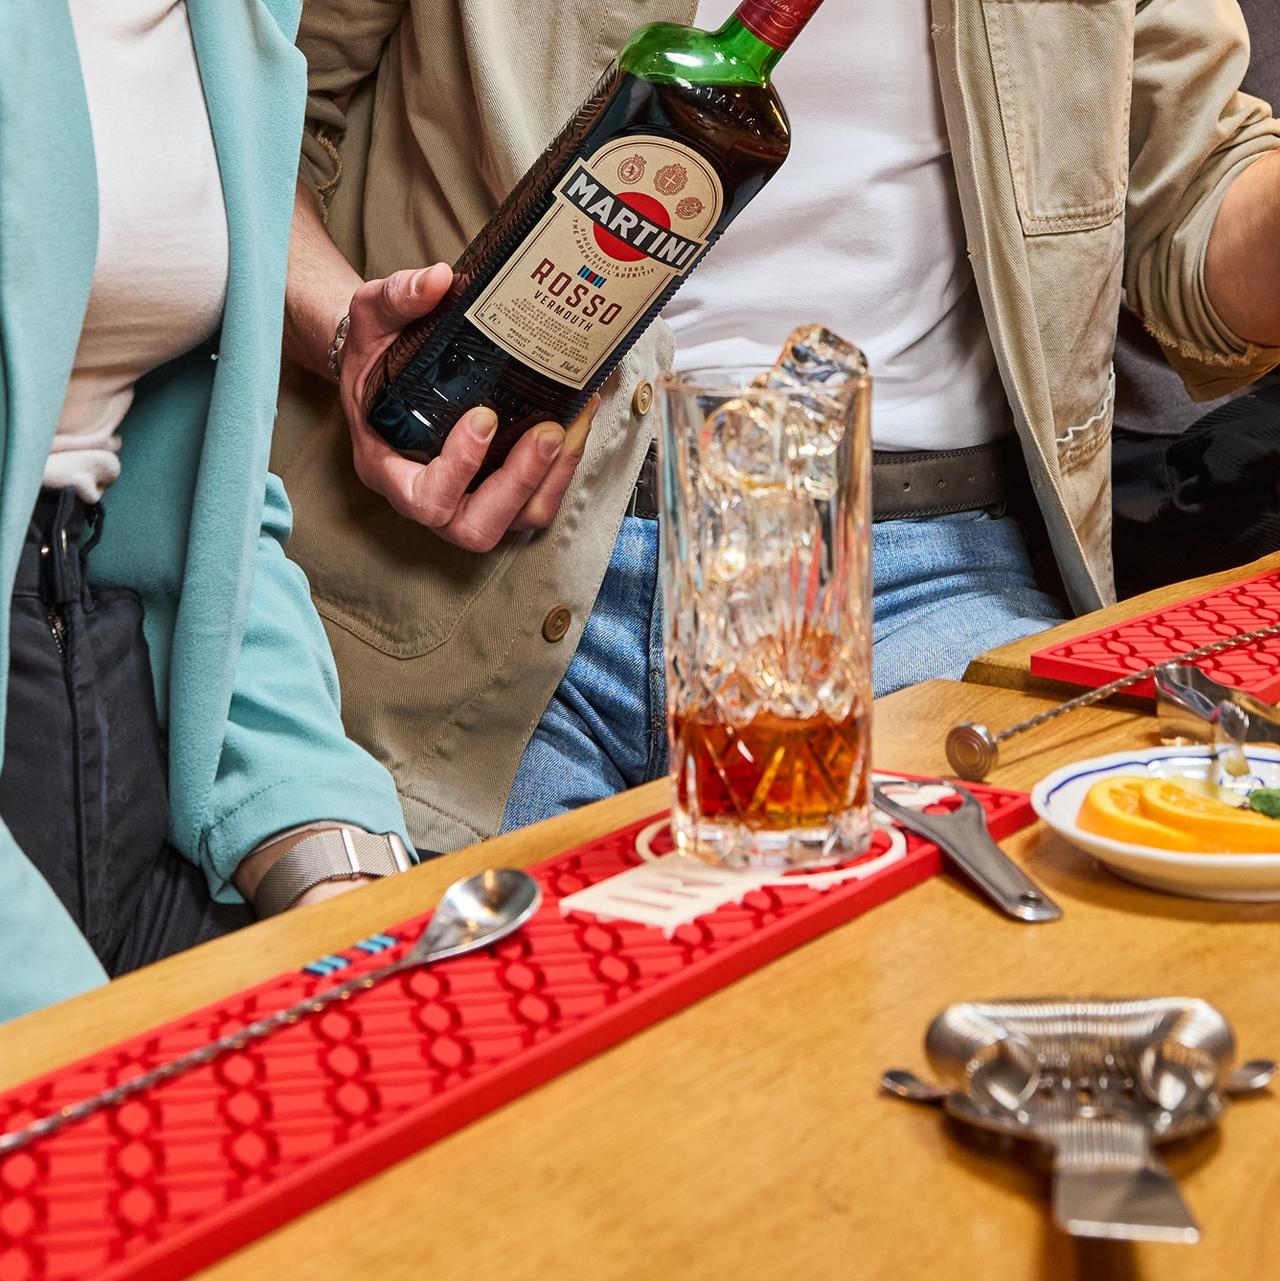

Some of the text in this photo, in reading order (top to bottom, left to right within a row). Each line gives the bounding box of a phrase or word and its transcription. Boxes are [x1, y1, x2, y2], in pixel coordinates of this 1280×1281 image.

[567, 173, 696, 267] MARTINI
[531, 257, 623, 326] ROSSO
[534, 289, 594, 332] VERMOUTH
[510, 328, 554, 358] PRODUCT PRODUIT
